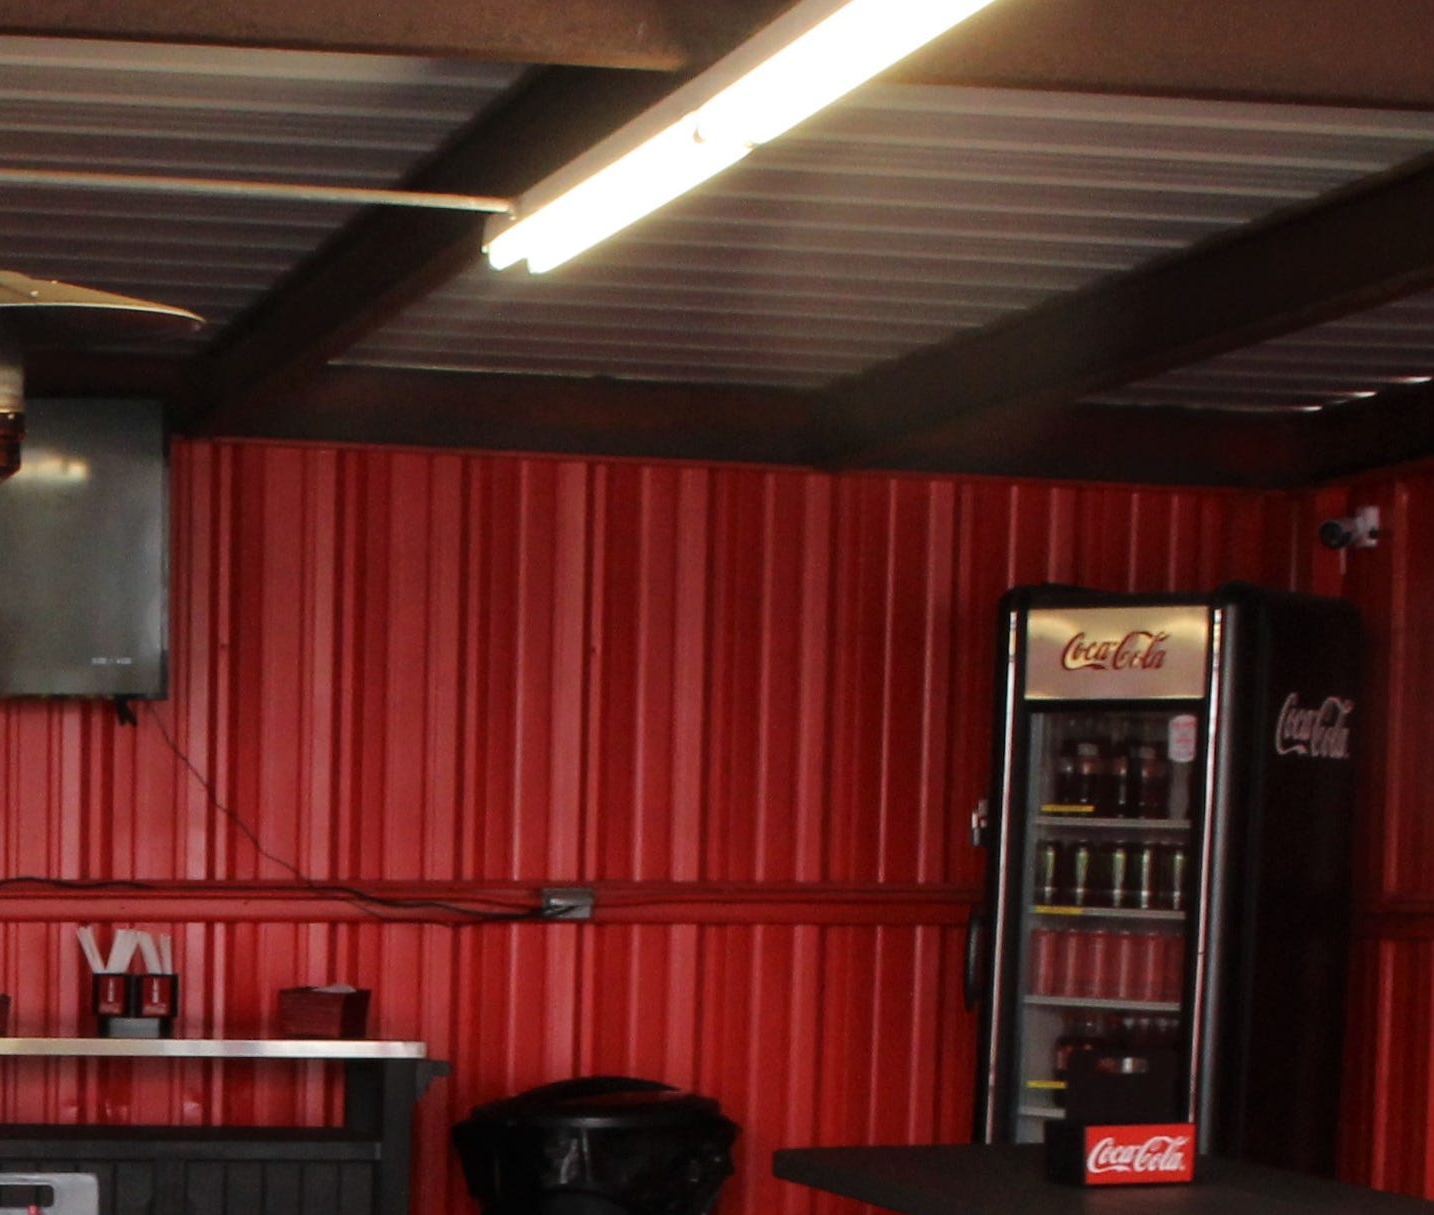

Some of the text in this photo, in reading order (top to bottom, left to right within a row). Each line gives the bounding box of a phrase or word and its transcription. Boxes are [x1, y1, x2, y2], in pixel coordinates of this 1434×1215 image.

[1061, 629, 1171, 672] Coca-Cola
[1276, 692, 1355, 759] Coca-Cola
[1086, 1135, 1190, 1174] Coca-Cola
